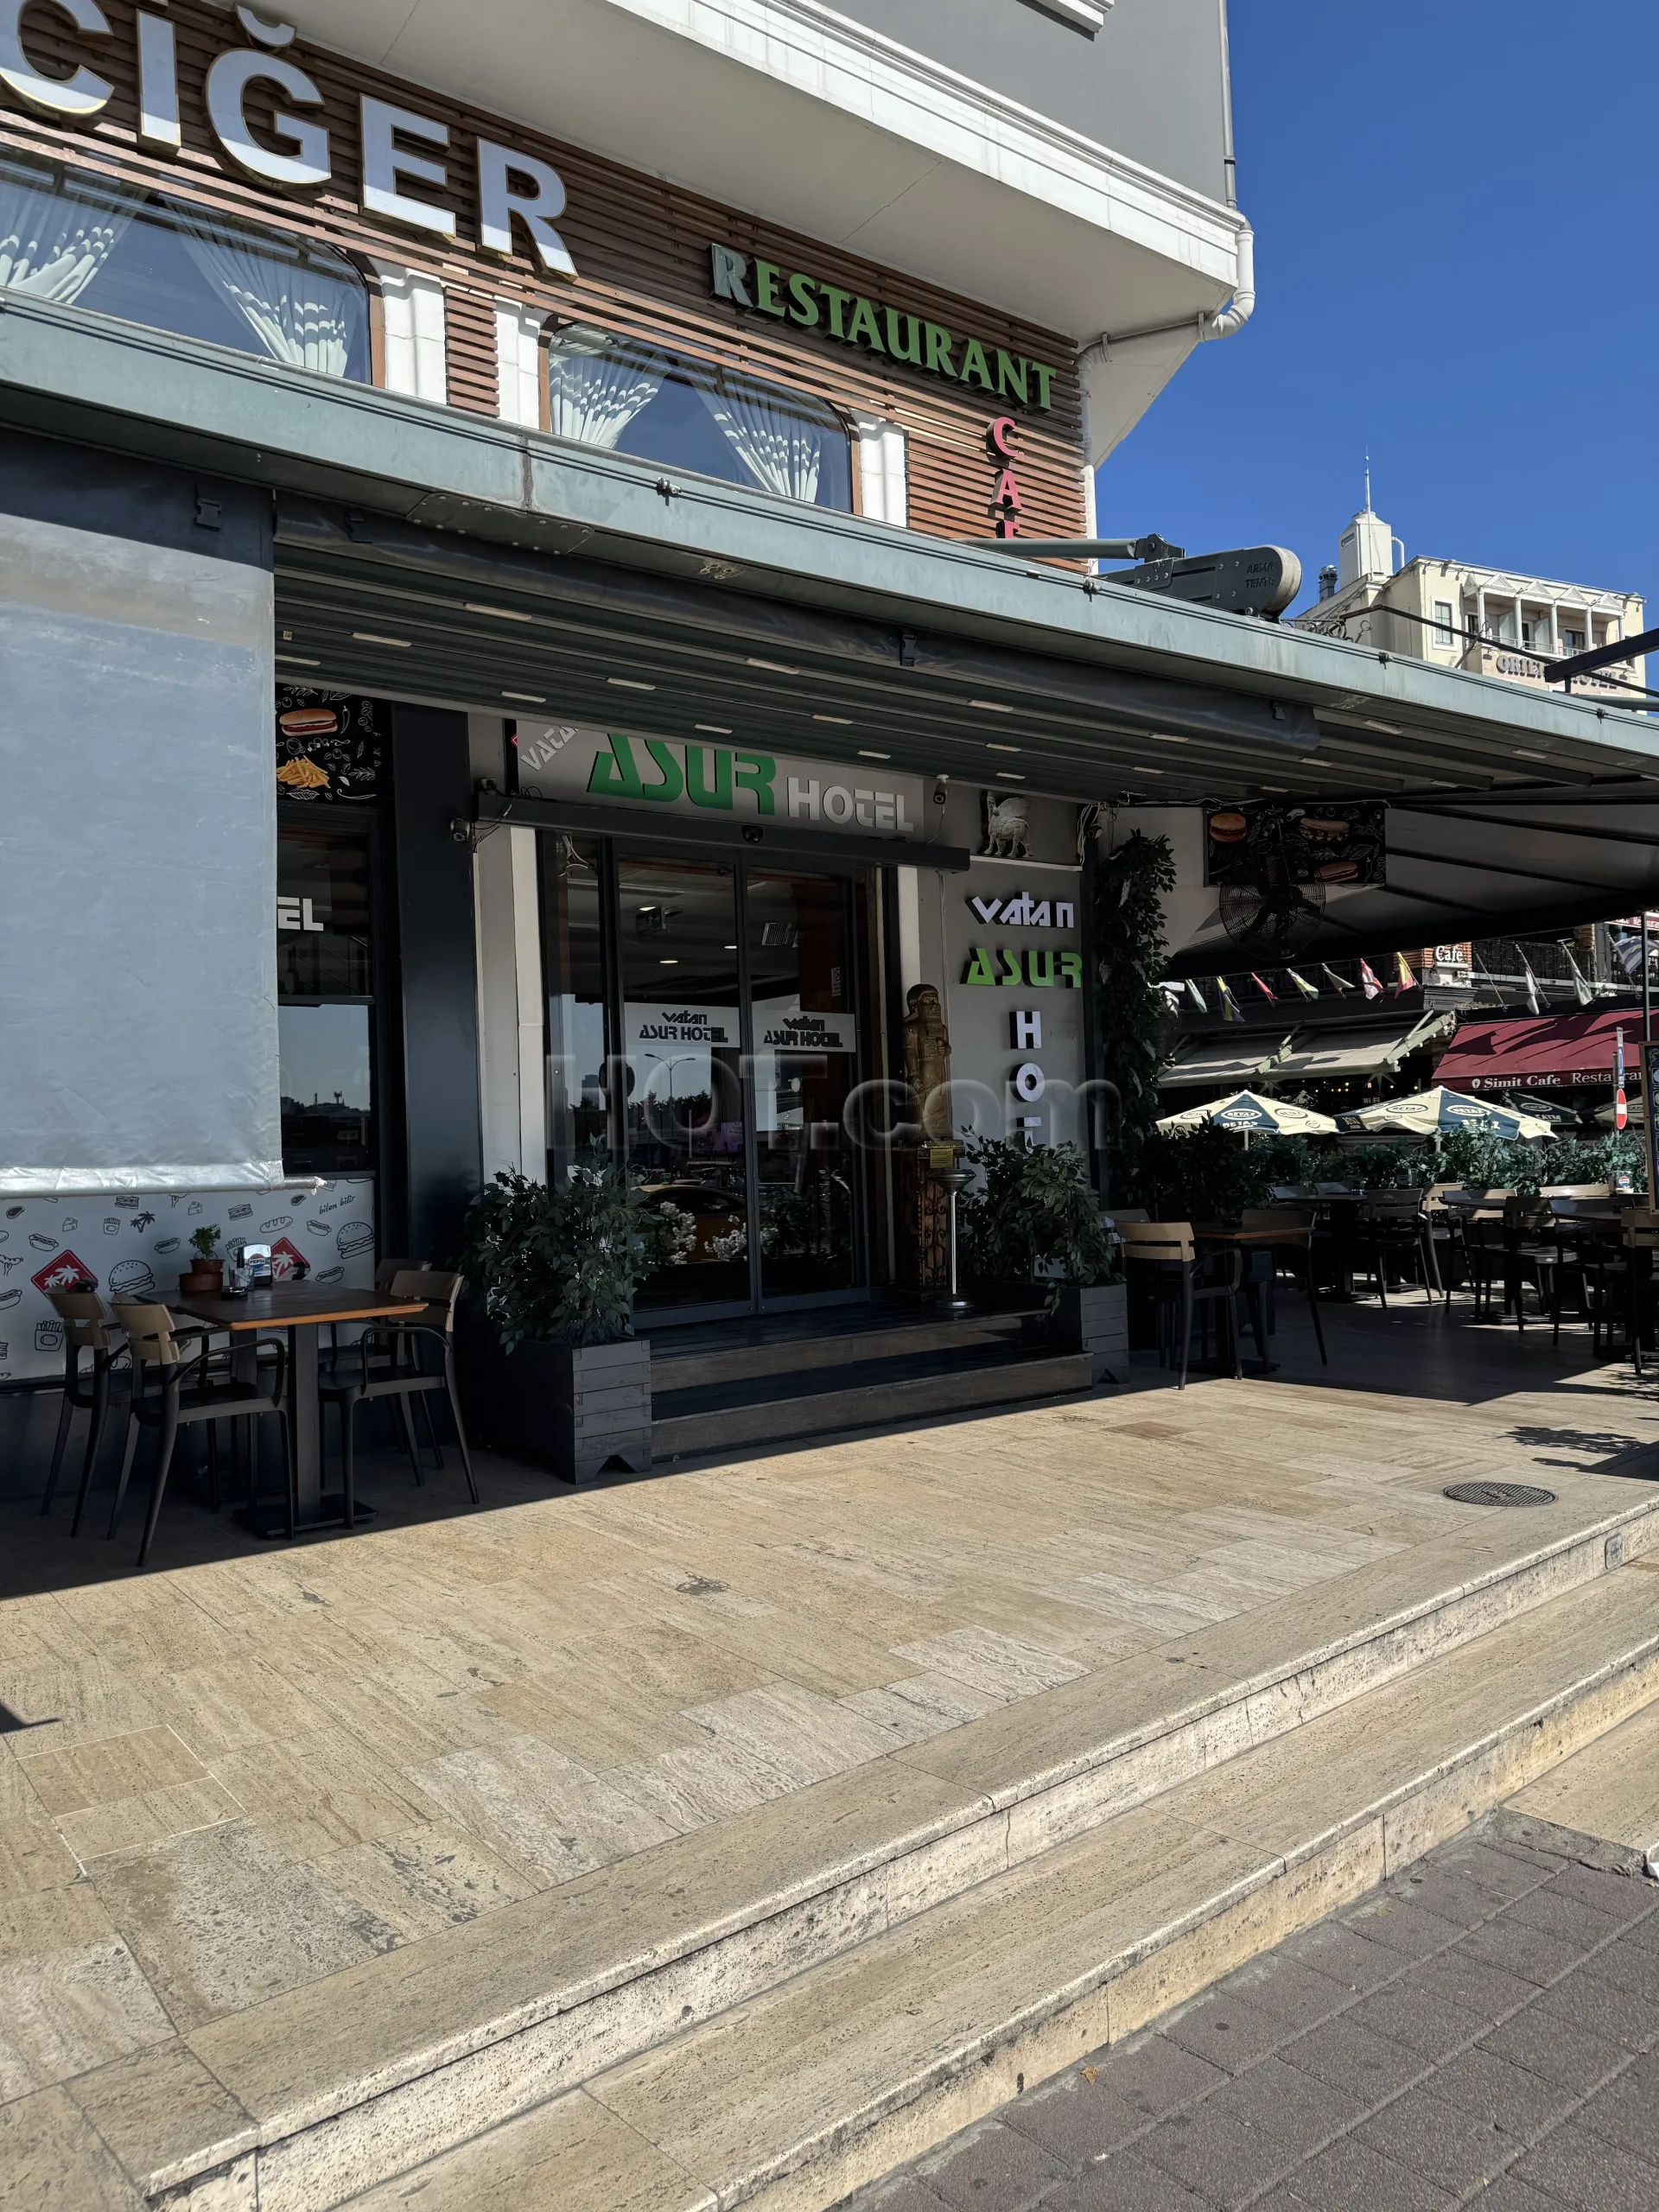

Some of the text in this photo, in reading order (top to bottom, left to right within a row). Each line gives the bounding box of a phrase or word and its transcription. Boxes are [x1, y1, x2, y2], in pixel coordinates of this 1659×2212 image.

[710, 243, 1056, 414] RESTAURANT
[587, 733, 914, 832] ASUR HOTEL
[1435, 944, 1463, 962] Cafe
[961, 947, 1083, 988] ASUR
[639, 1024, 728, 1044] ASUR HOTEL
[763, 1029, 843, 1048] ASUR HOTEL
[1484, 1071, 1643, 1089] Simit Cafe Restara
[319, 1194, 356, 1215] bilen bilir
